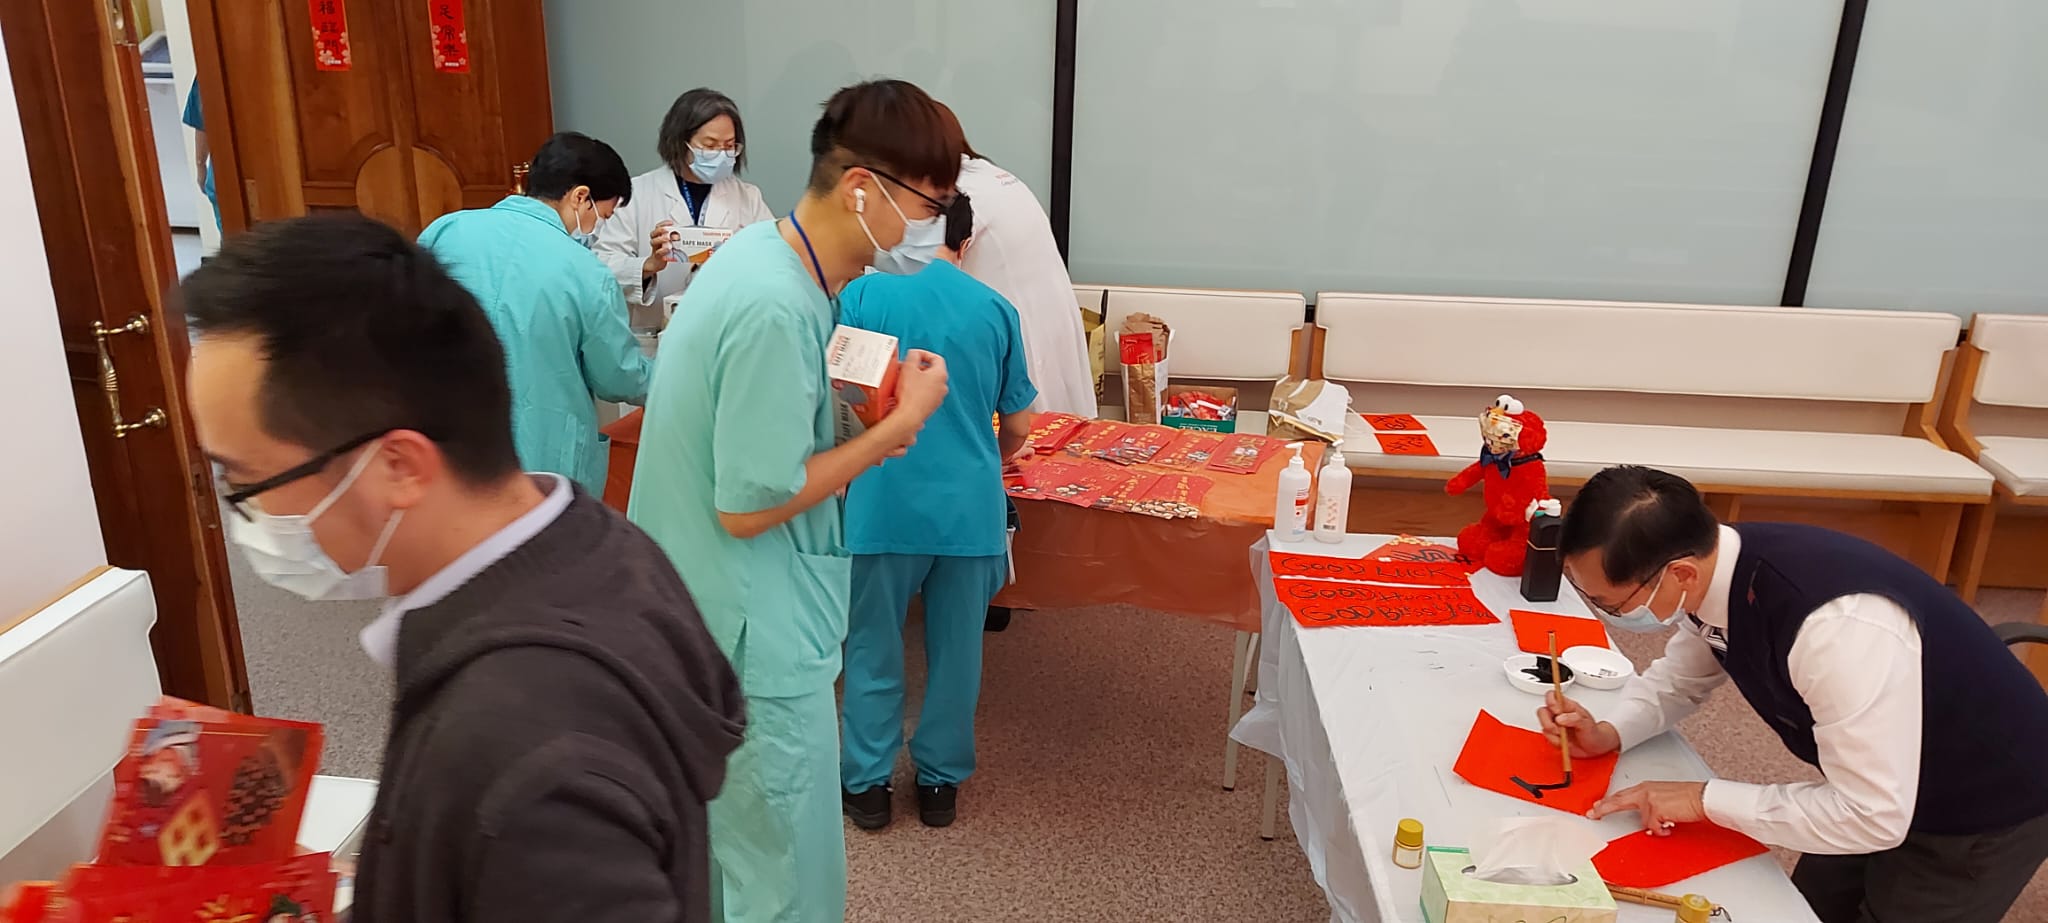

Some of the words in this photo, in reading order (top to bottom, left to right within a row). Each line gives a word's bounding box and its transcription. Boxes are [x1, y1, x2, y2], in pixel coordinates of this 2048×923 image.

[1281, 557, 1365, 574] GOOD
[1376, 564, 1466, 582] LUCK
[1289, 583, 1376, 601] GOOD
[1301, 605, 1374, 621] GOD
